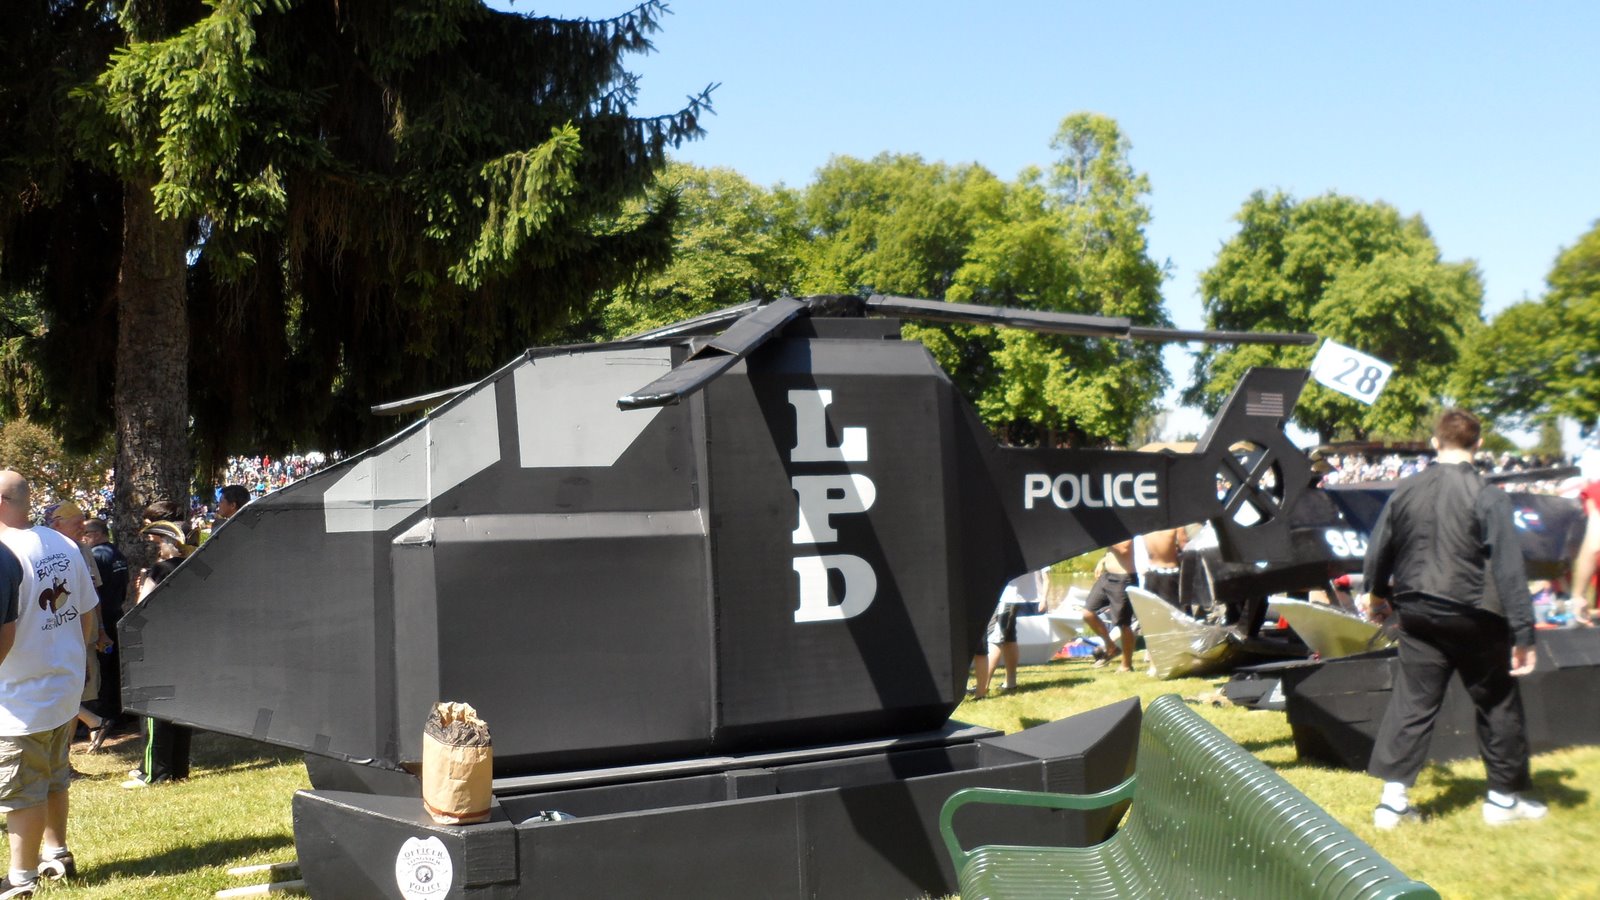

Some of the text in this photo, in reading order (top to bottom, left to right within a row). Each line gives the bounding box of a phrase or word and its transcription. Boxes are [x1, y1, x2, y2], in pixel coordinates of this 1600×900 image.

[1332, 356, 1383, 395] 28
[1024, 472, 1159, 509] POLICE
[404, 847, 443, 858] OFFICER
[409, 882, 440, 892] POLICE
